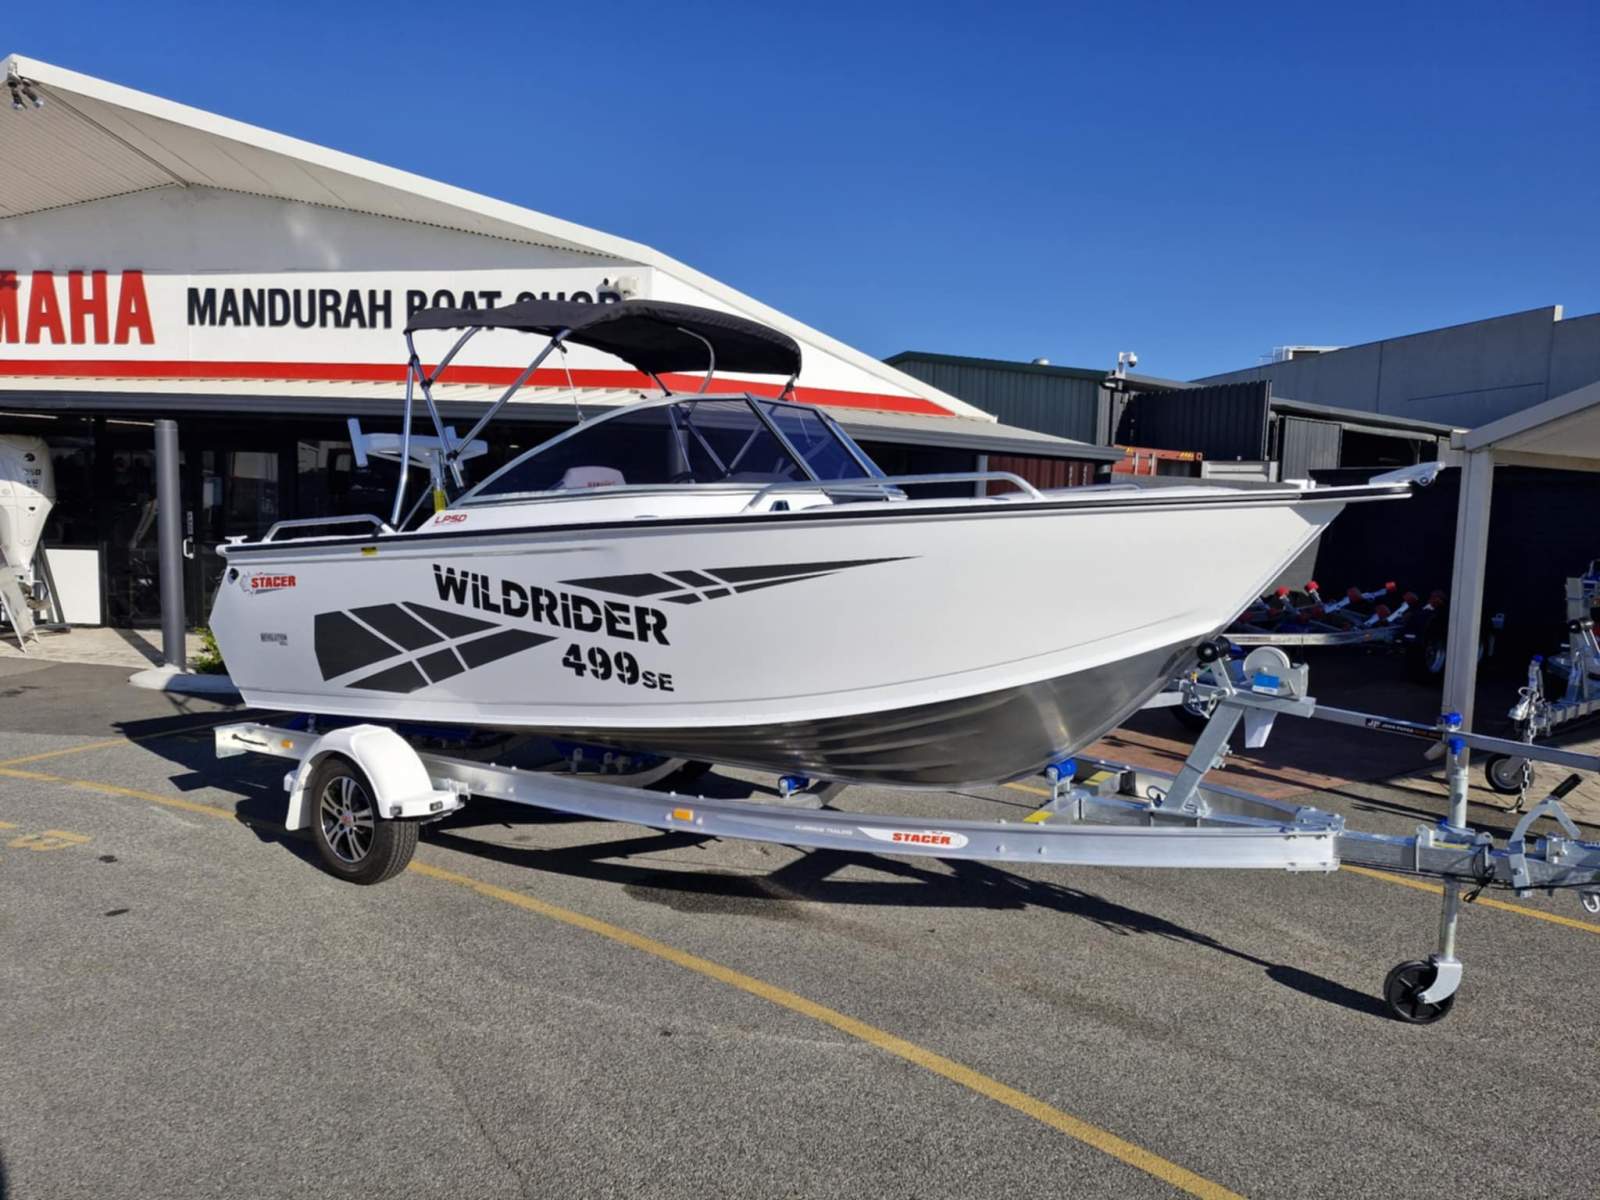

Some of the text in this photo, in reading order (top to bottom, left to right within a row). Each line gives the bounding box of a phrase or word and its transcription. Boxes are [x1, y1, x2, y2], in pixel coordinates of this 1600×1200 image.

[187, 287, 392, 330] MANDURAH
[251, 575, 296, 588] STACER
[892, 832, 952, 845] STACER
